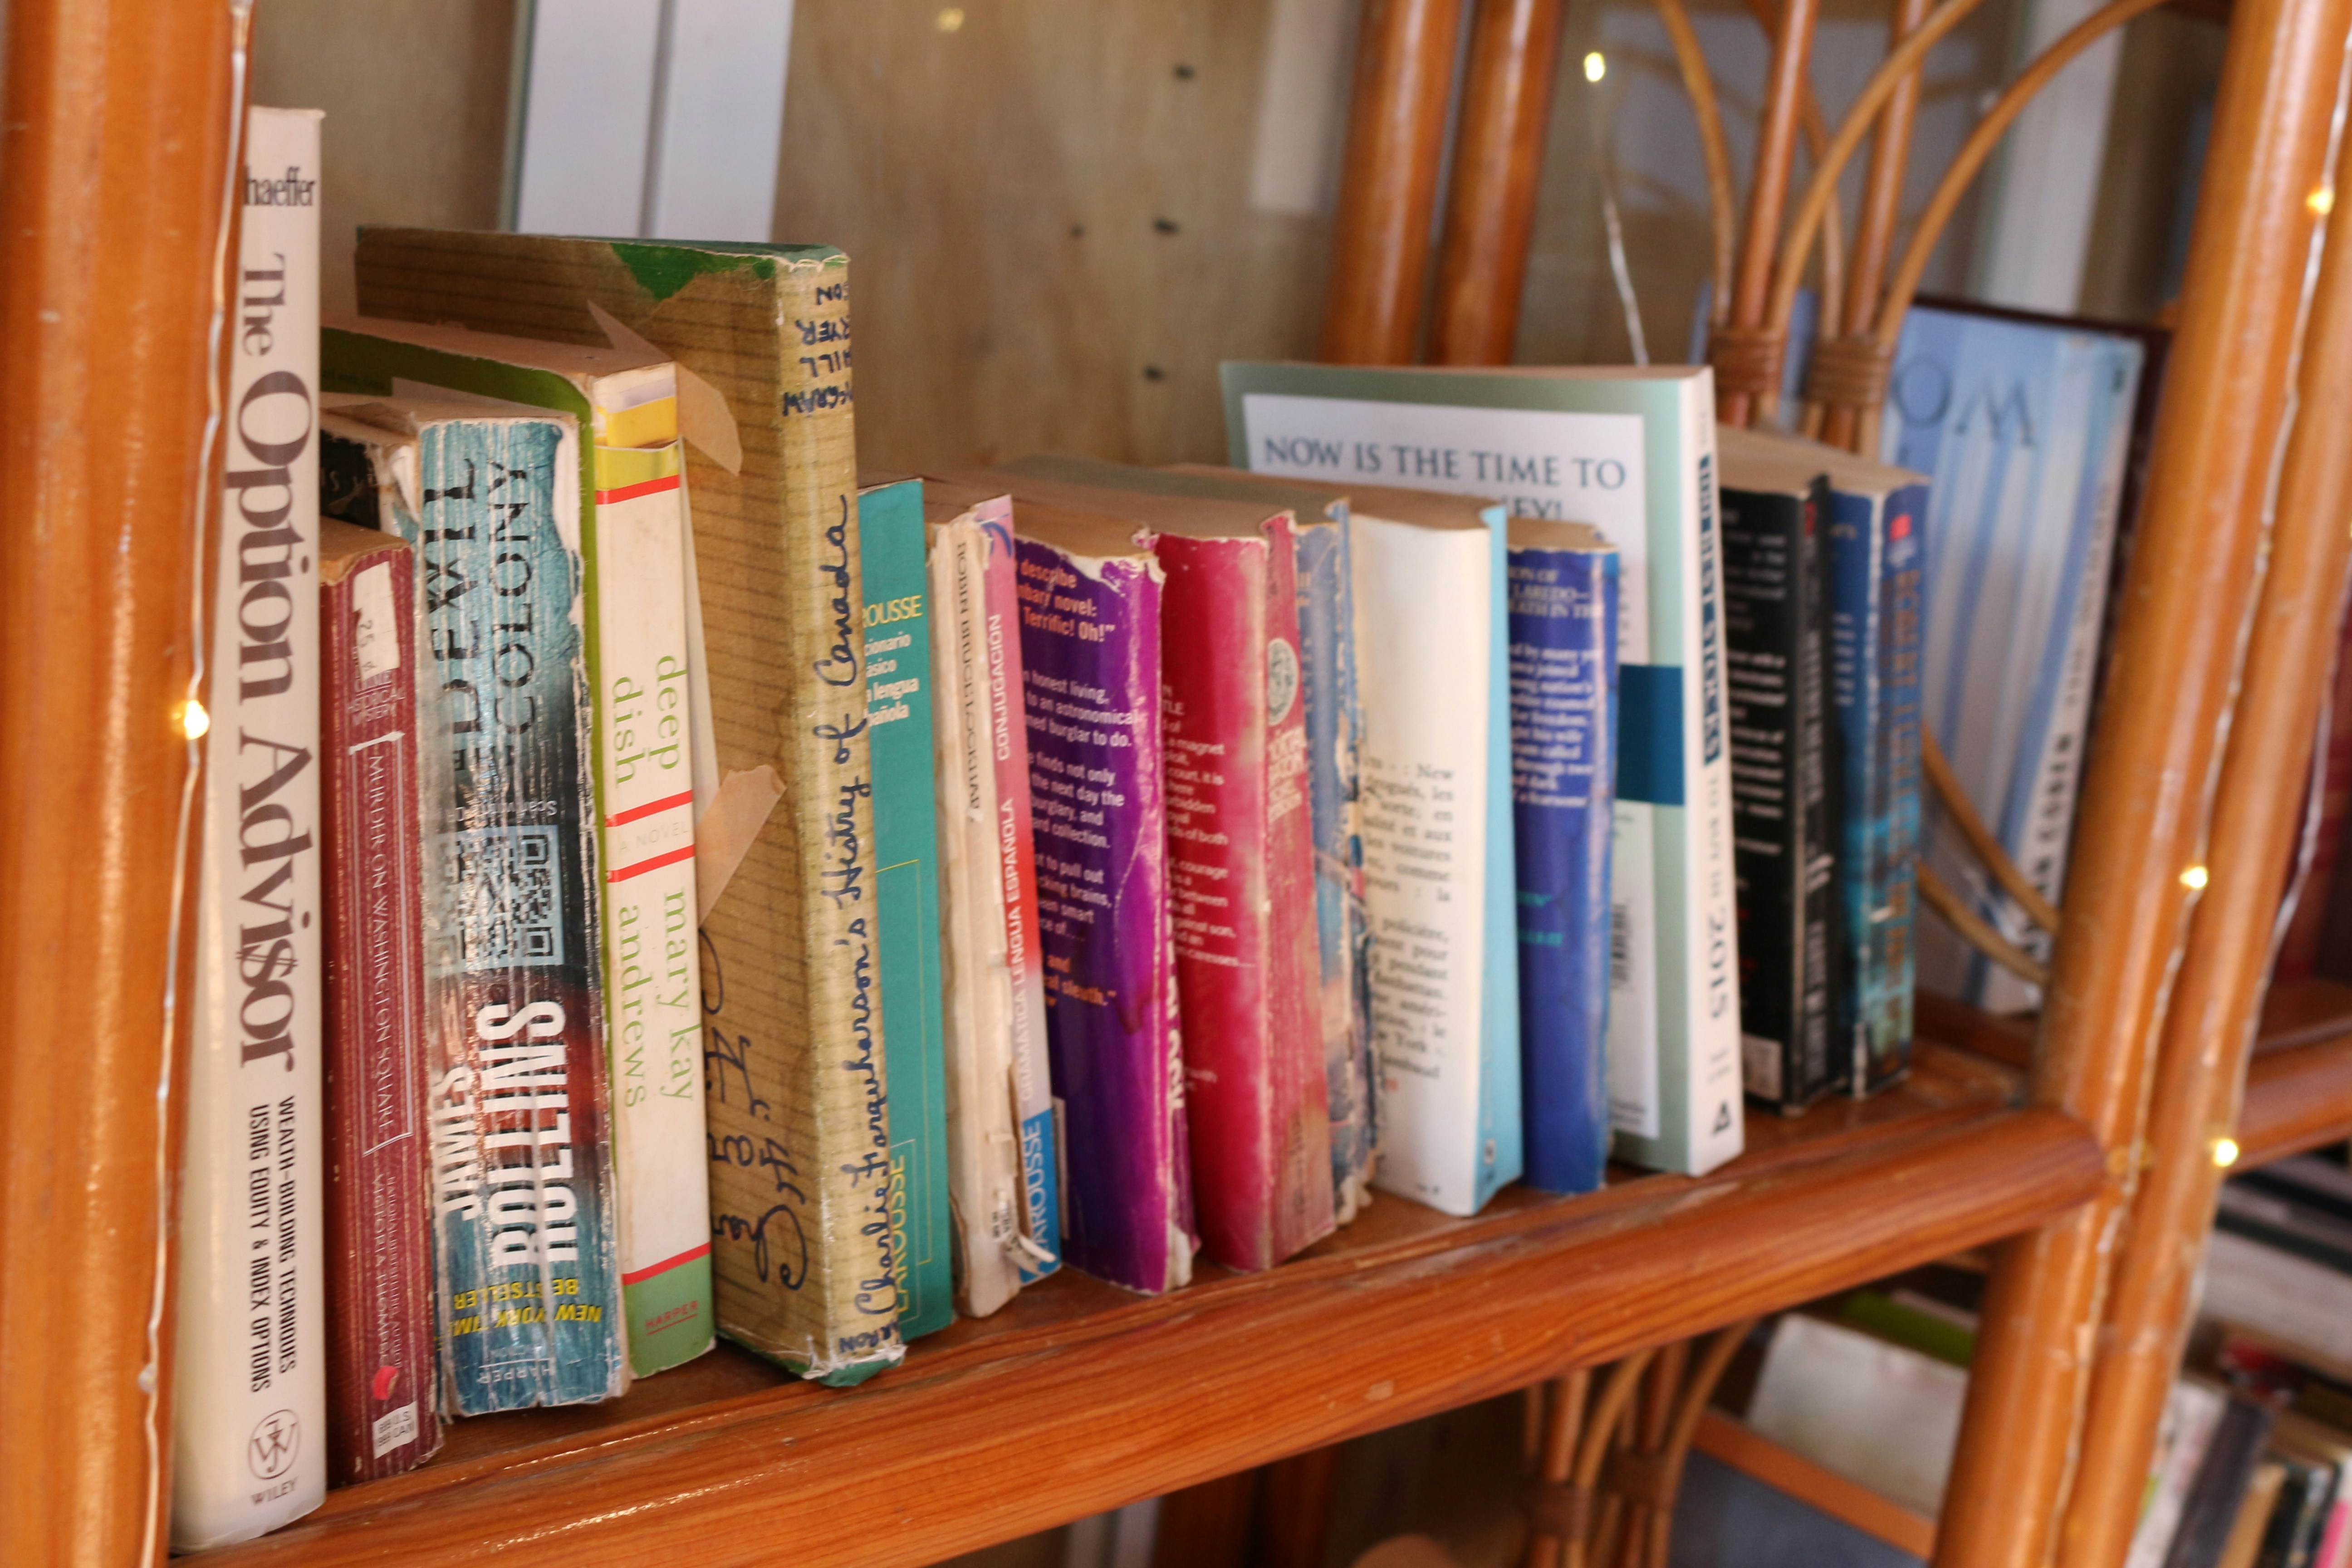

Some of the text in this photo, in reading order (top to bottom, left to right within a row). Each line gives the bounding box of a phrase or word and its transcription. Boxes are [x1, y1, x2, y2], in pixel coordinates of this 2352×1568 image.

[242, 253, 285, 356] The
[1264, 437, 1626, 489] NOW IS THE TIME TO
[225, 370, 312, 706] Option
[488, 460, 534, 734] COLONY
[814, 495, 857, 686] Canada
[1021, 559, 1077, 588] describe
[873, 678, 920, 701] lengua
[1032, 669, 1067, 694] honest
[1039, 697, 1055, 712] an
[613, 656, 687, 788] deep dish
[814, 714, 868, 764] of
[1049, 718, 1091, 743] burglar
[1093, 730, 1107, 746] to
[1036, 751, 1064, 773] finds
[1067, 763, 1085, 779] not
[1087, 768, 1116, 788] only
[1051, 781, 1074, 798] next
[1077, 785, 1100, 807] day
[1101, 790, 1125, 808] the
[619, 820, 689, 853] A NOVEL
[1079, 810, 1104, 827] and
[1083, 869, 1105, 885] out
[368, 755, 394, 1131] MURDER ON WASHINGTON SQUARE
[1008, 906, 1026, 986] LENGUA
[1707, 910, 1730, 1020] 2015
[617, 888, 701, 1109] mary kay andrews
[429, 1001, 579, 1267] JAMES ROLLINS
[1023, 1120, 1049, 1251] AROUSSE
[250, 1105, 271, 1393] USING EQUITY & INDEX OPTIONS
[854, 1185, 897, 1315] Charlie
[453, 1278, 578, 1310] BESTSELLER
[495, 1304, 602, 1328] NEW YORK
[644, 1299, 699, 1329] HARPER
[279, 1269, 298, 1374] TECHNIQUES
[477, 1365, 552, 1384] HARPER
[251, 1475, 299, 1506] WILEY
